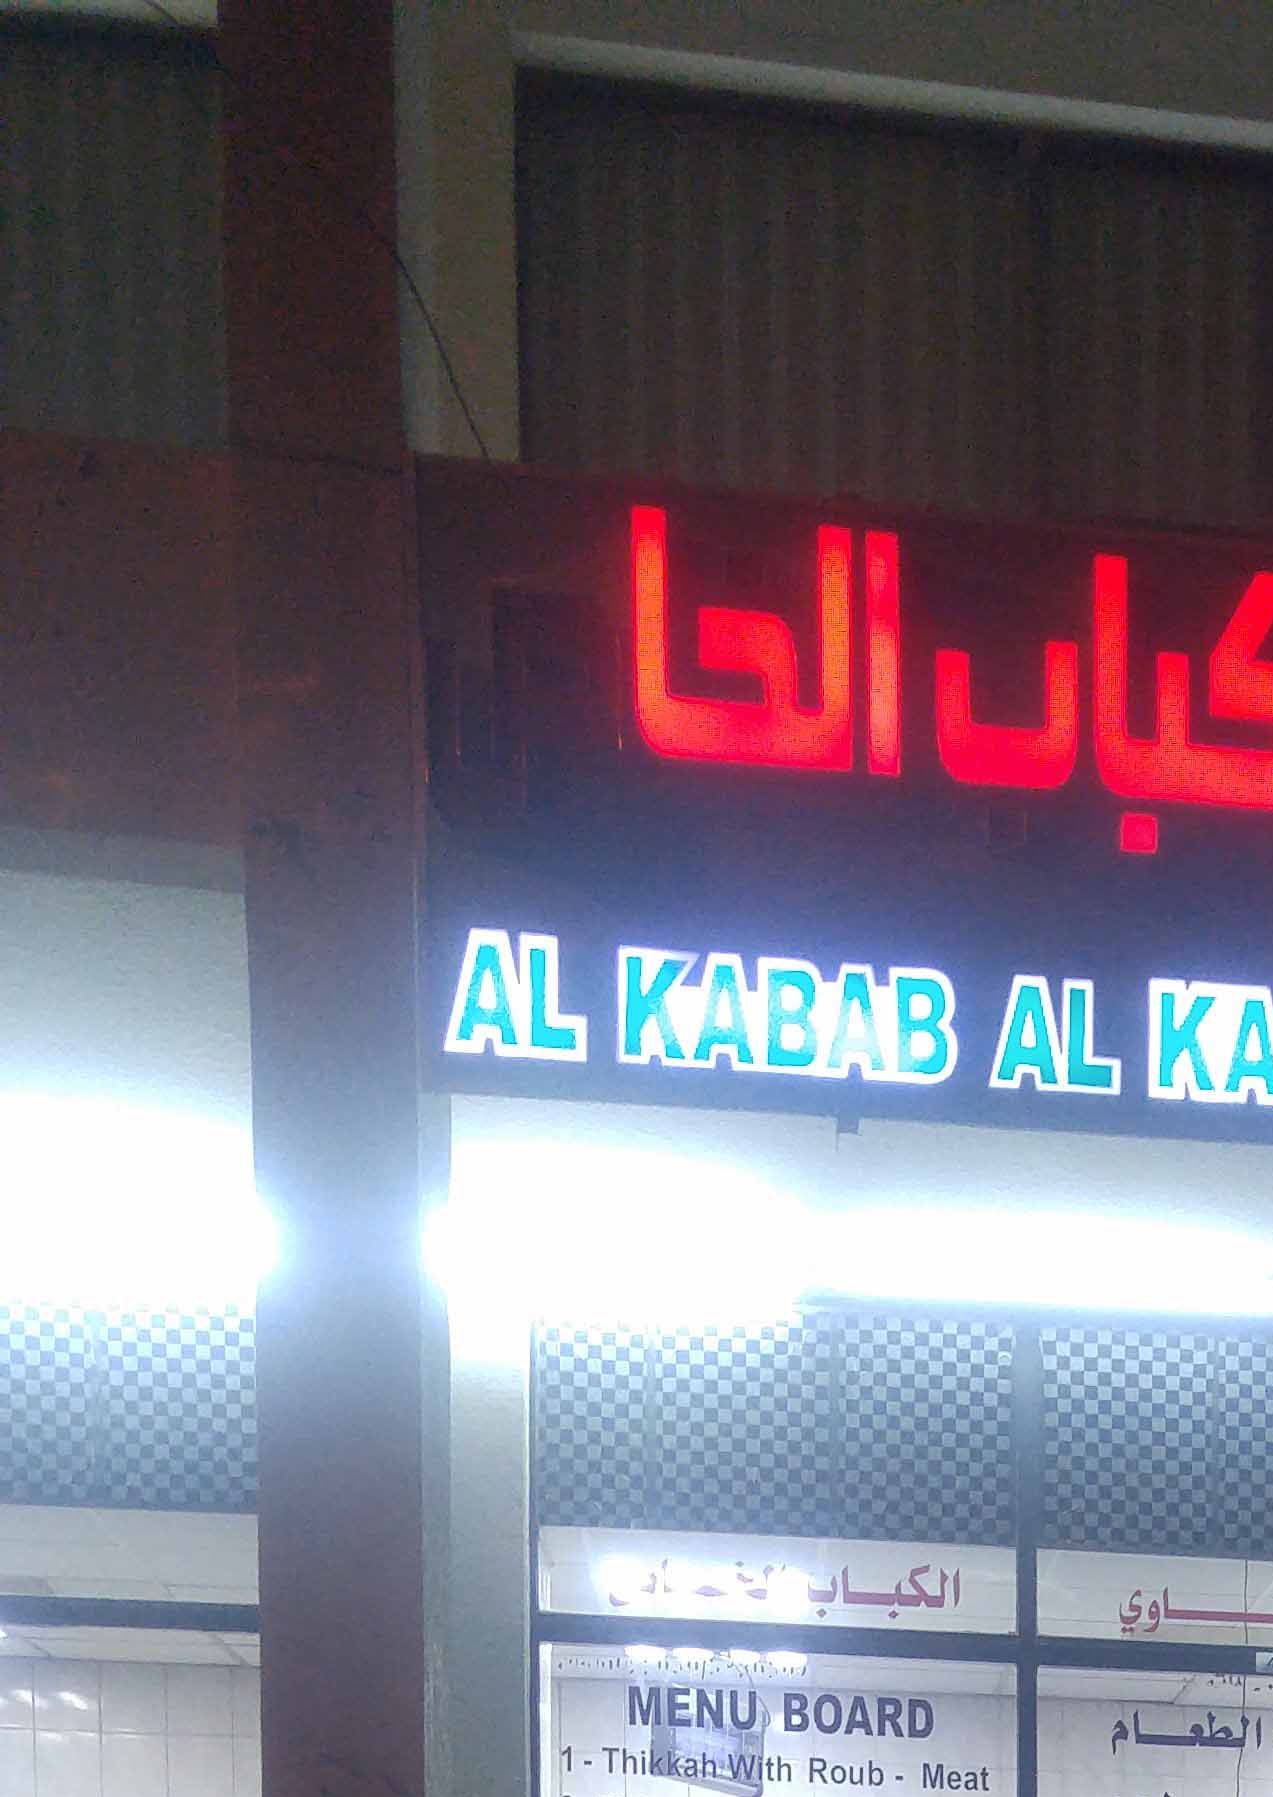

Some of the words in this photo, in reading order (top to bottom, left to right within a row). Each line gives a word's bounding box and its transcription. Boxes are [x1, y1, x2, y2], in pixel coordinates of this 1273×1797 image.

[444, 927, 588, 1063] AL
[617, 945, 958, 1085] KABAB
[988, 972, 1121, 1096] AL
[627, 1685, 757, 1731] MENU
[783, 1692, 933, 1739] BOARD
[1111, 1709, 1261, 1755] الطعام
[602, 1747, 717, 1780] Thikkah
[729, 1753, 791, 1783] With
[809, 1757, 884, 1786] Roub
[922, 1763, 990, 1792] Meat
